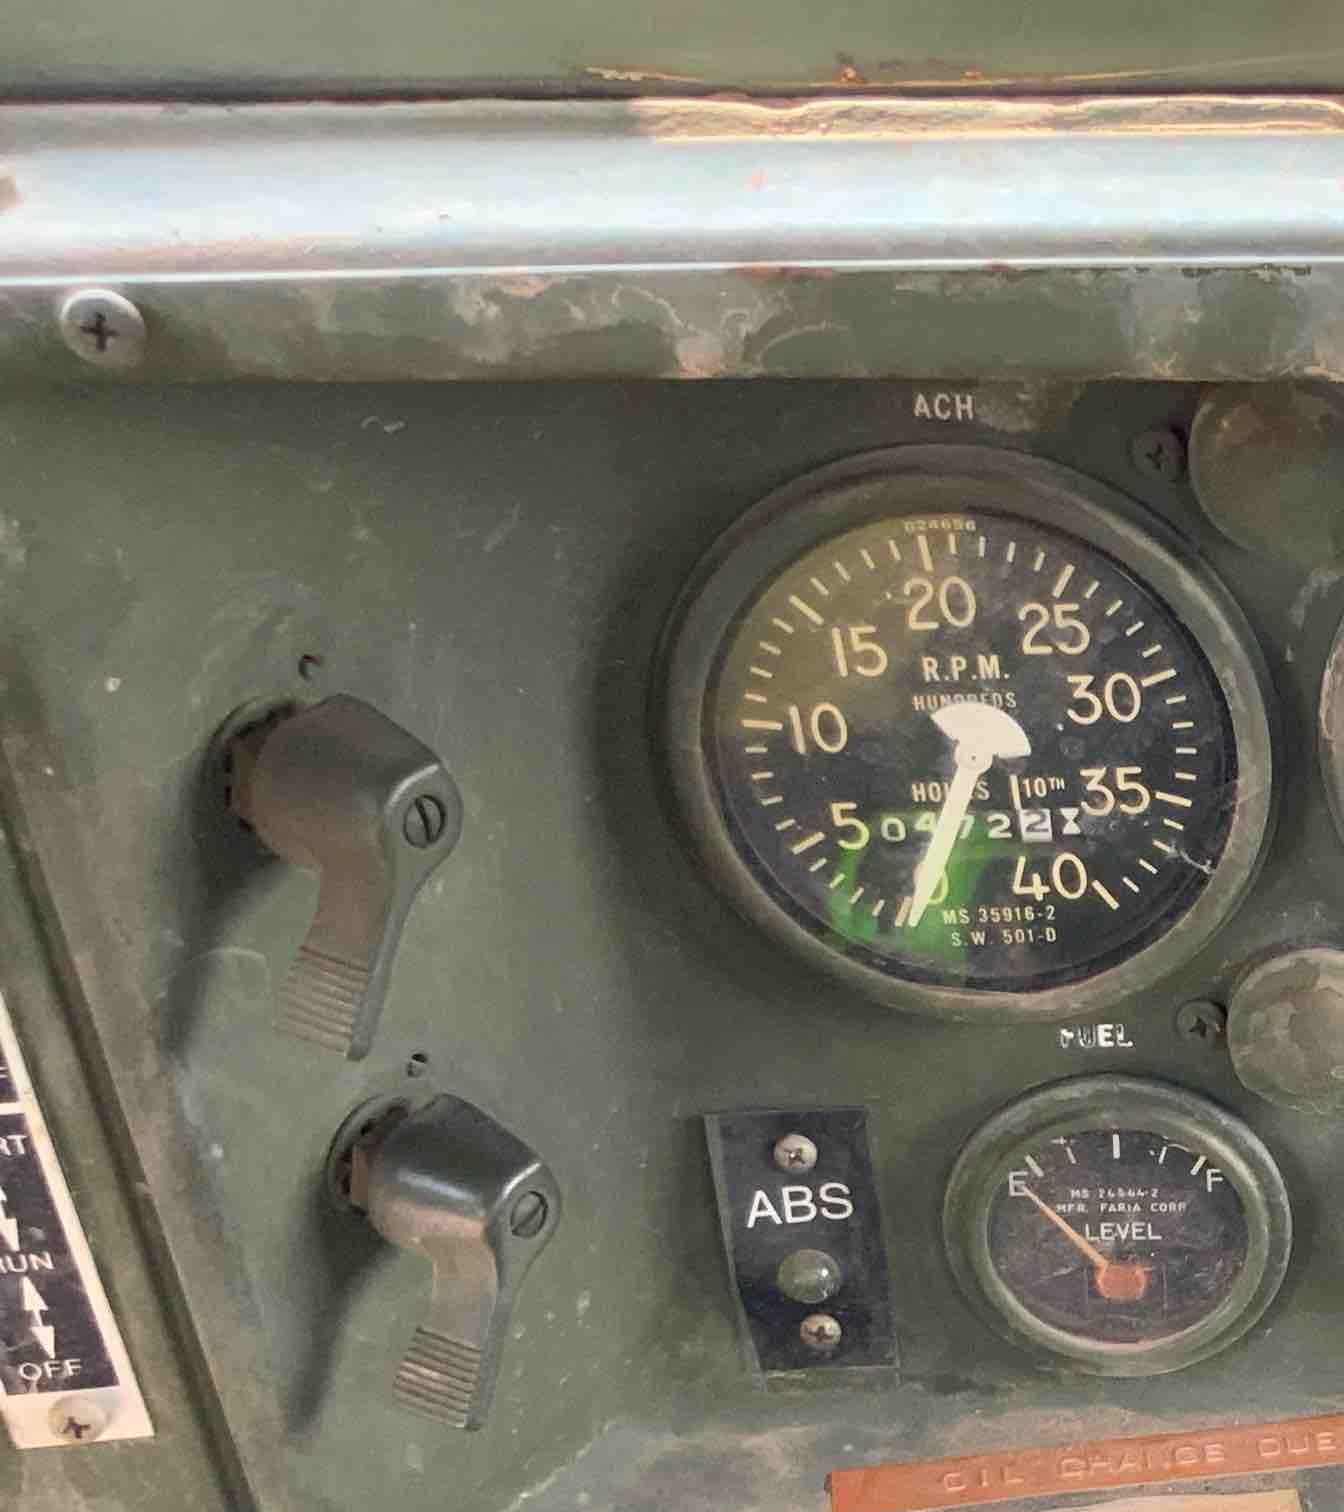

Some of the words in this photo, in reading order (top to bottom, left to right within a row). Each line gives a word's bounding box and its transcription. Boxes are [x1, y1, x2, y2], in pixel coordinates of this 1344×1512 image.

[904, 577, 975, 629] 20
[1018, 604, 1090, 655] 25
[832, 626, 888, 677] 15
[921, 655, 1010, 682] R.P.M.
[1067, 674, 1141, 724] 30
[789, 703, 848, 754] 10
[1080, 767, 1150, 815] 35
[832, 803, 869, 850] 5
[1013, 853, 1087, 901] 40
[942, 909, 970, 924] MS
[979, 905, 1056, 922] 35916-2
[1060, 1023, 1134, 1049] FUEL
[1008, 1171, 1030, 1197] E
[1206, 1169, 1224, 1192] F
[746, 1182, 853, 1228] ABS
[1100, 1202, 1142, 1213] FARIA
[1085, 1222, 1162, 1241] LEVEL
[18, 1359, 82, 1380] OFF
[1256, 1431, 1339, 1458] DUE
